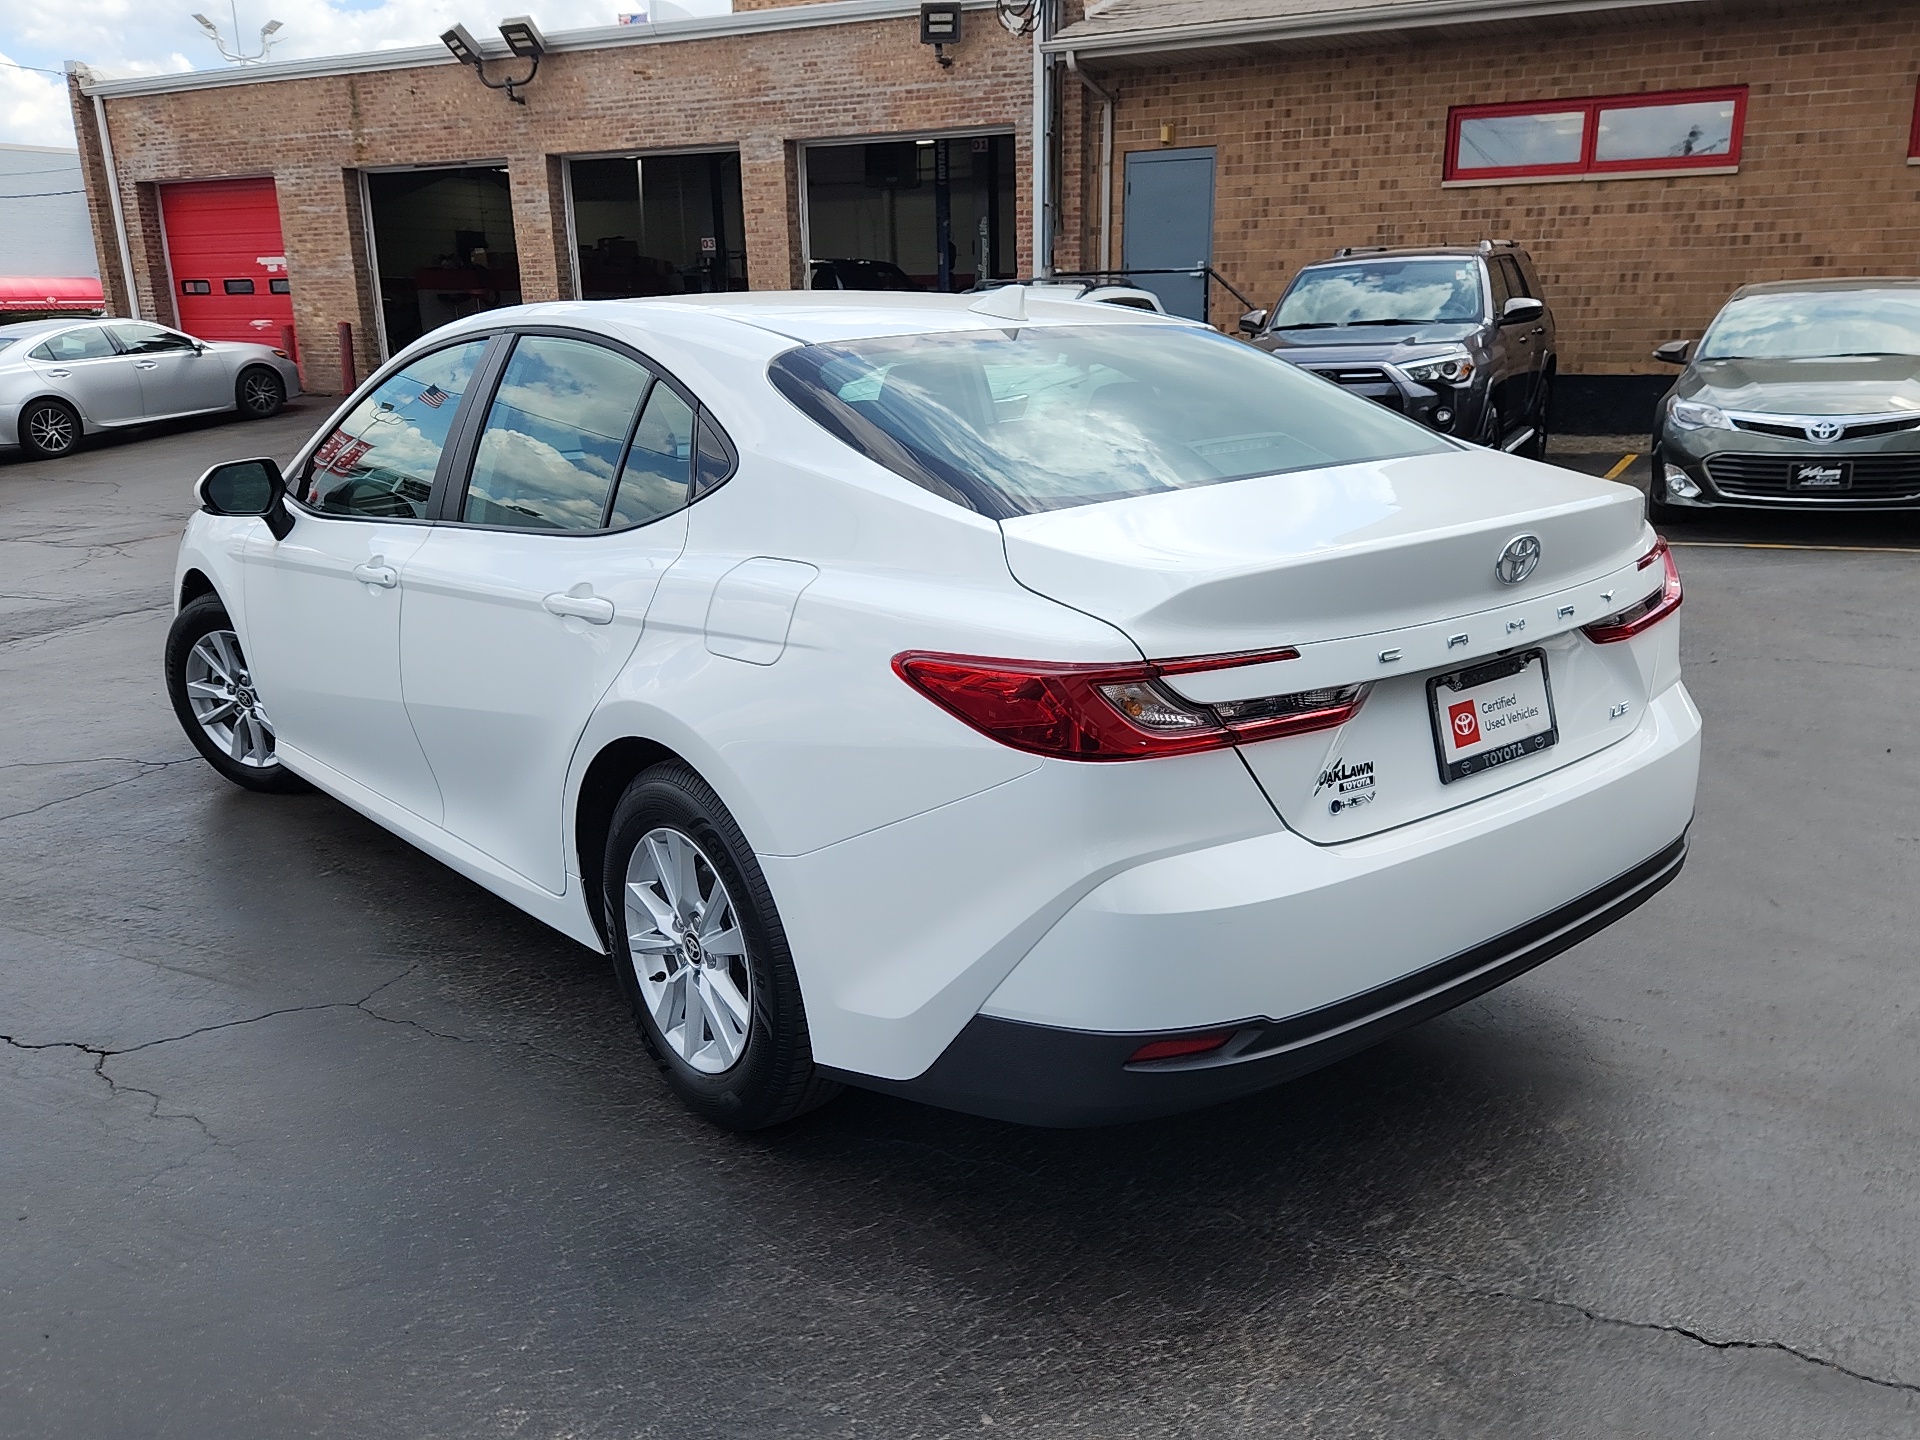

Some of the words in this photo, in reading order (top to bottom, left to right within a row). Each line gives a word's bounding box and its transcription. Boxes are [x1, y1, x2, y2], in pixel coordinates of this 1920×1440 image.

[972, 139, 988, 151] 01
[702, 239, 715, 249] 03
[1378, 589, 1615, 664] CAMRY
[1481, 693, 1517, 714] Certified
[1609, 700, 1629, 720] LE
[1484, 715, 1506, 732] Used
[1506, 706, 1540, 724] Vehicles
[1482, 743, 1525, 767] TOYOTA
[1342, 777, 1371, 791] TOYOTA
